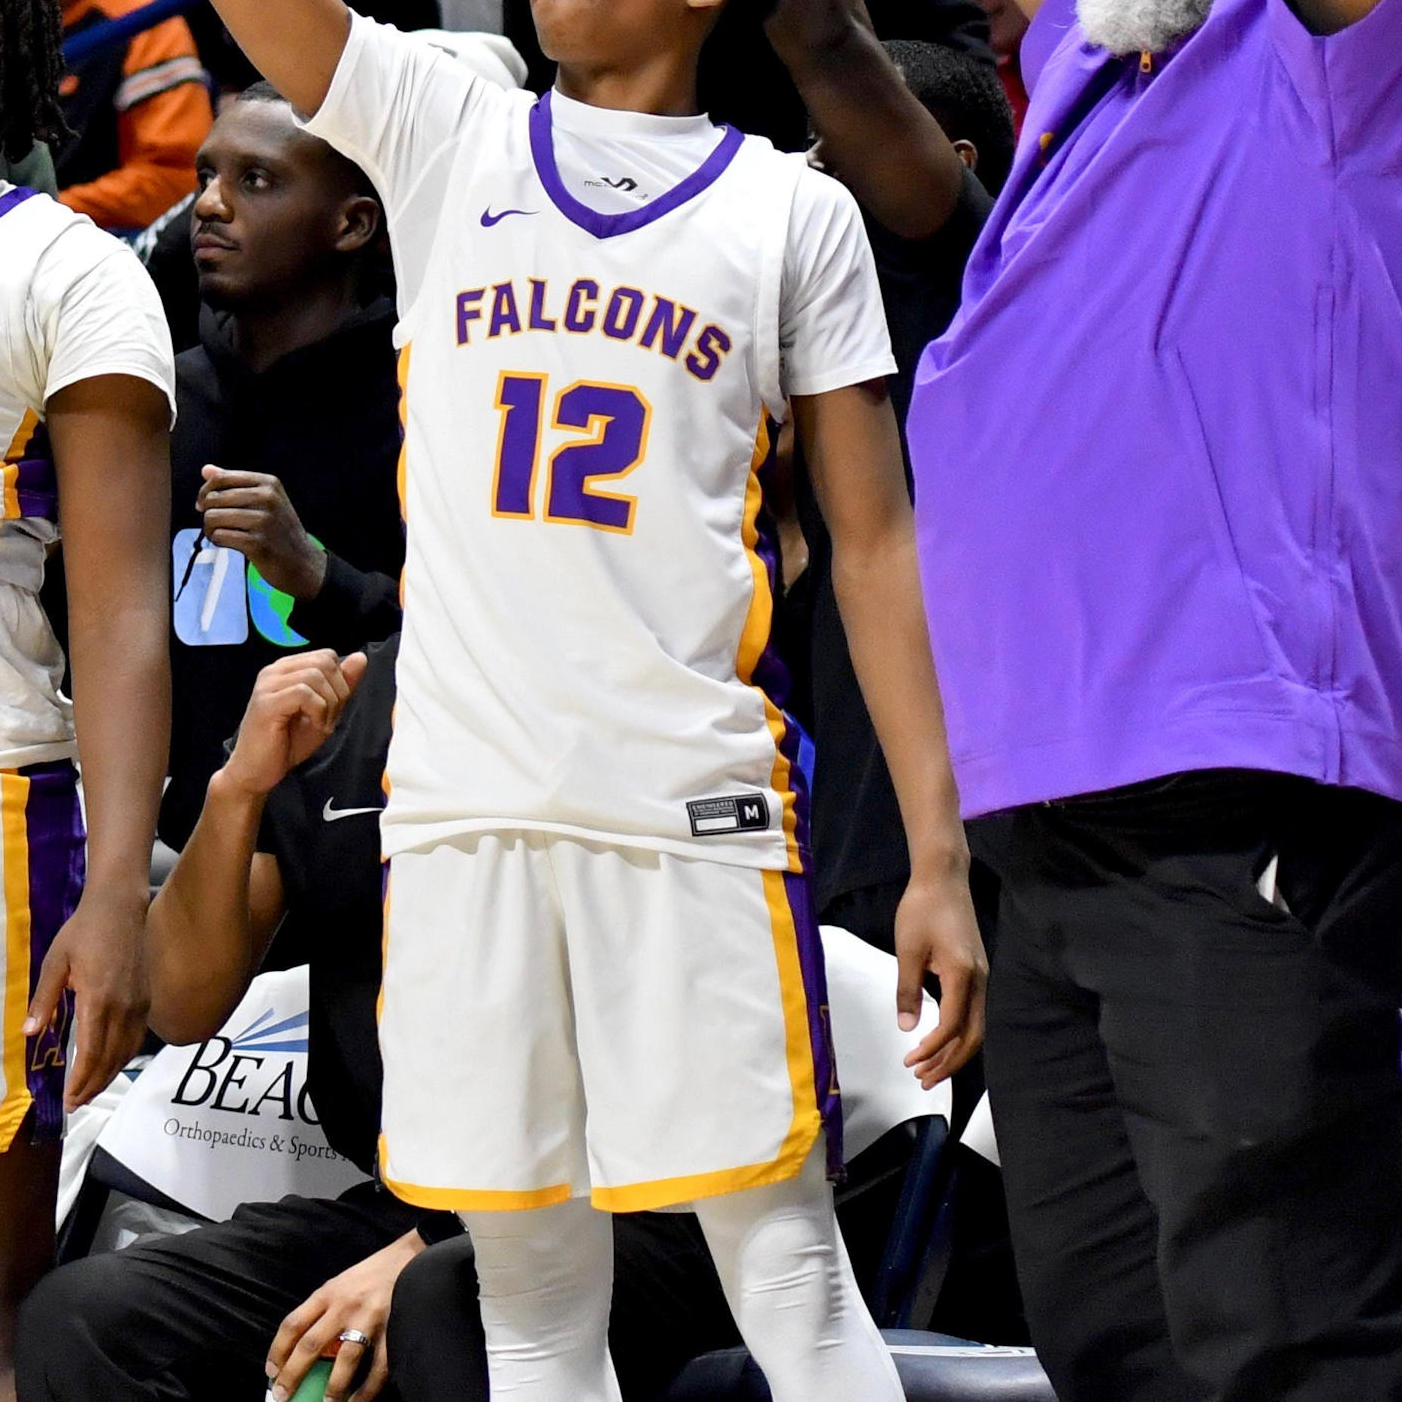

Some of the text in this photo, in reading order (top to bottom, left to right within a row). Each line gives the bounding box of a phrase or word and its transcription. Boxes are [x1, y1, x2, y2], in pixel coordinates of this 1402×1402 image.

[456, 276, 733, 383] FALCONS
[491, 369, 653, 536] 12
[190, 548, 229, 632] 7
[744, 804, 760, 821] M
[163, 1118, 266, 1150] Orthopaedics
[269, 1134, 285, 1153] &
